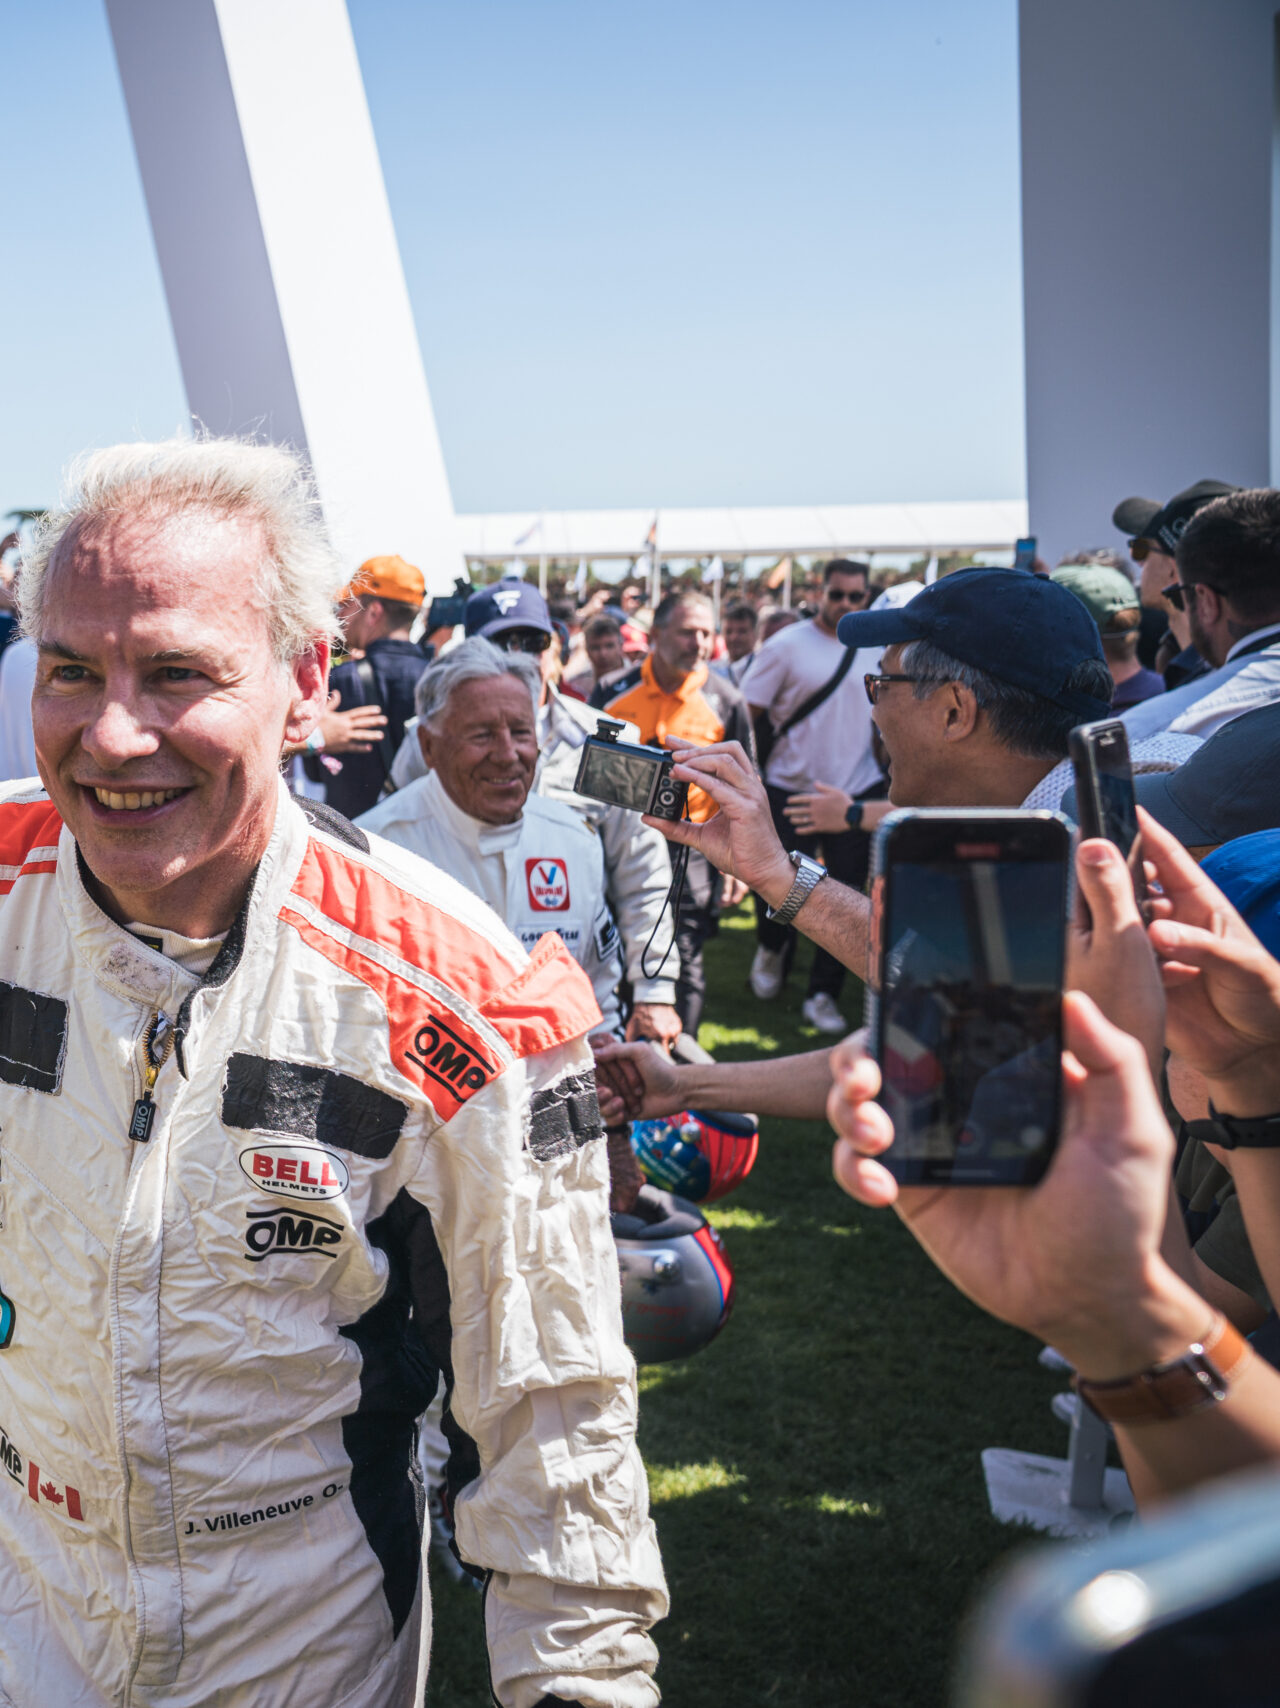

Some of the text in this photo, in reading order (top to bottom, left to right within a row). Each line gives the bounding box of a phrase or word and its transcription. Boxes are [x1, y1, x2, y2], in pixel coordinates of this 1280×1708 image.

[414, 1026, 486, 1089] OMP
[135, 1106, 148, 1136] OMP
[252, 1153, 339, 1187] BELL
[261, 1179, 327, 1195] HELMETS
[245, 1216, 342, 1253] OMP
[185, 1483, 344, 1535] J. Villeneuve O-
